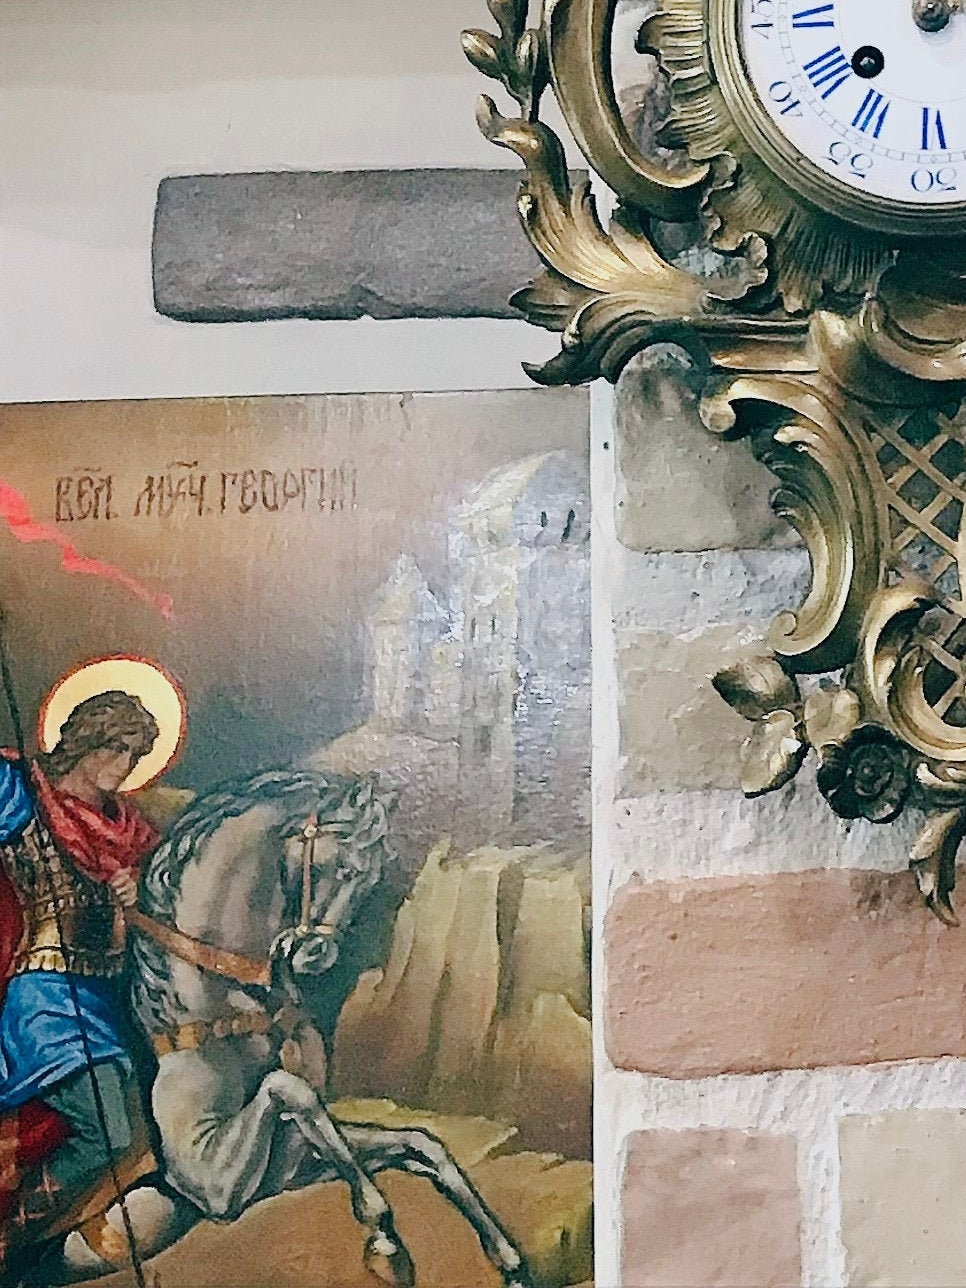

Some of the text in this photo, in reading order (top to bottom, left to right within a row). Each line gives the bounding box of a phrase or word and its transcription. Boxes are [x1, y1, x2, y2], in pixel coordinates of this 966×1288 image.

[803, 46, 854, 100] VIII
[769, 81, 803, 117] 40
[852, 88, 891, 139] VII
[922, 107, 947, 150] VI
